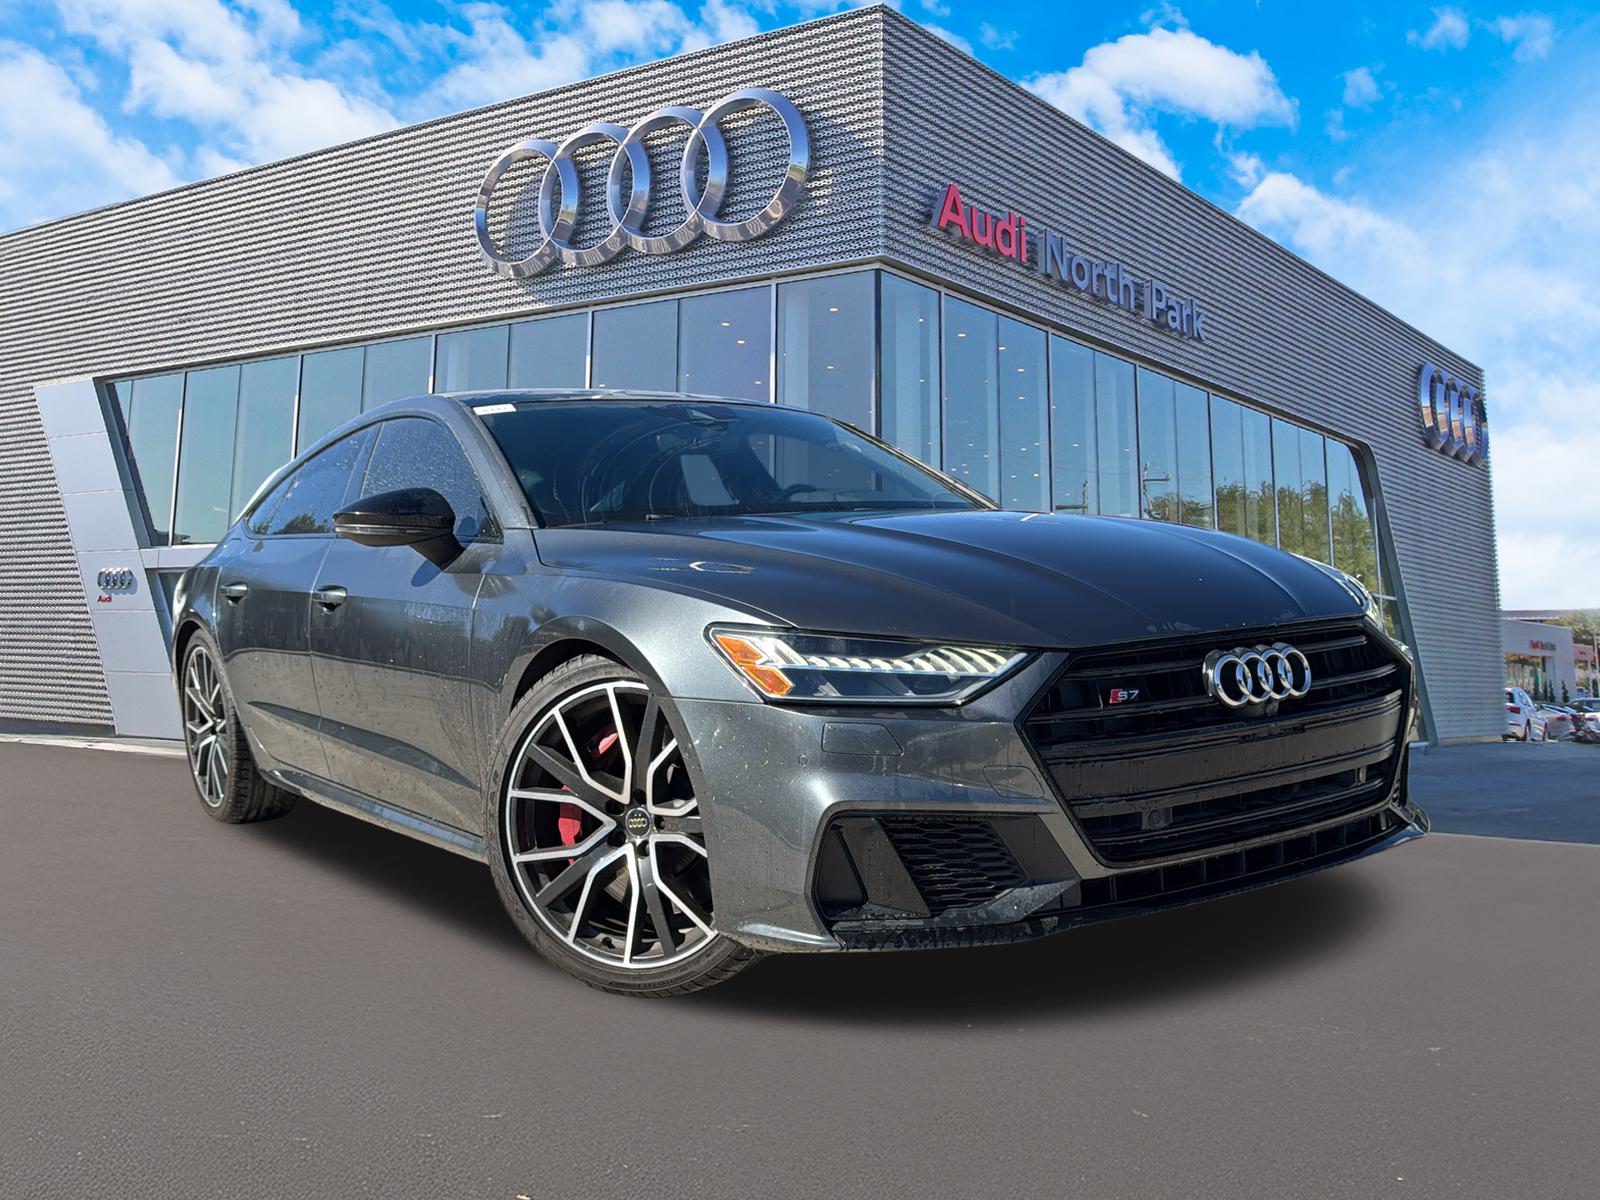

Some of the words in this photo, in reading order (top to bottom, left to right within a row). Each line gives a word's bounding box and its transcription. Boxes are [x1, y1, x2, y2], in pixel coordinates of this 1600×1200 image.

[932, 183, 1028, 264] Audi
[1039, 229, 1136, 313] North
[1145, 278, 1207, 341] Park
[1115, 689, 1139, 702] S7
